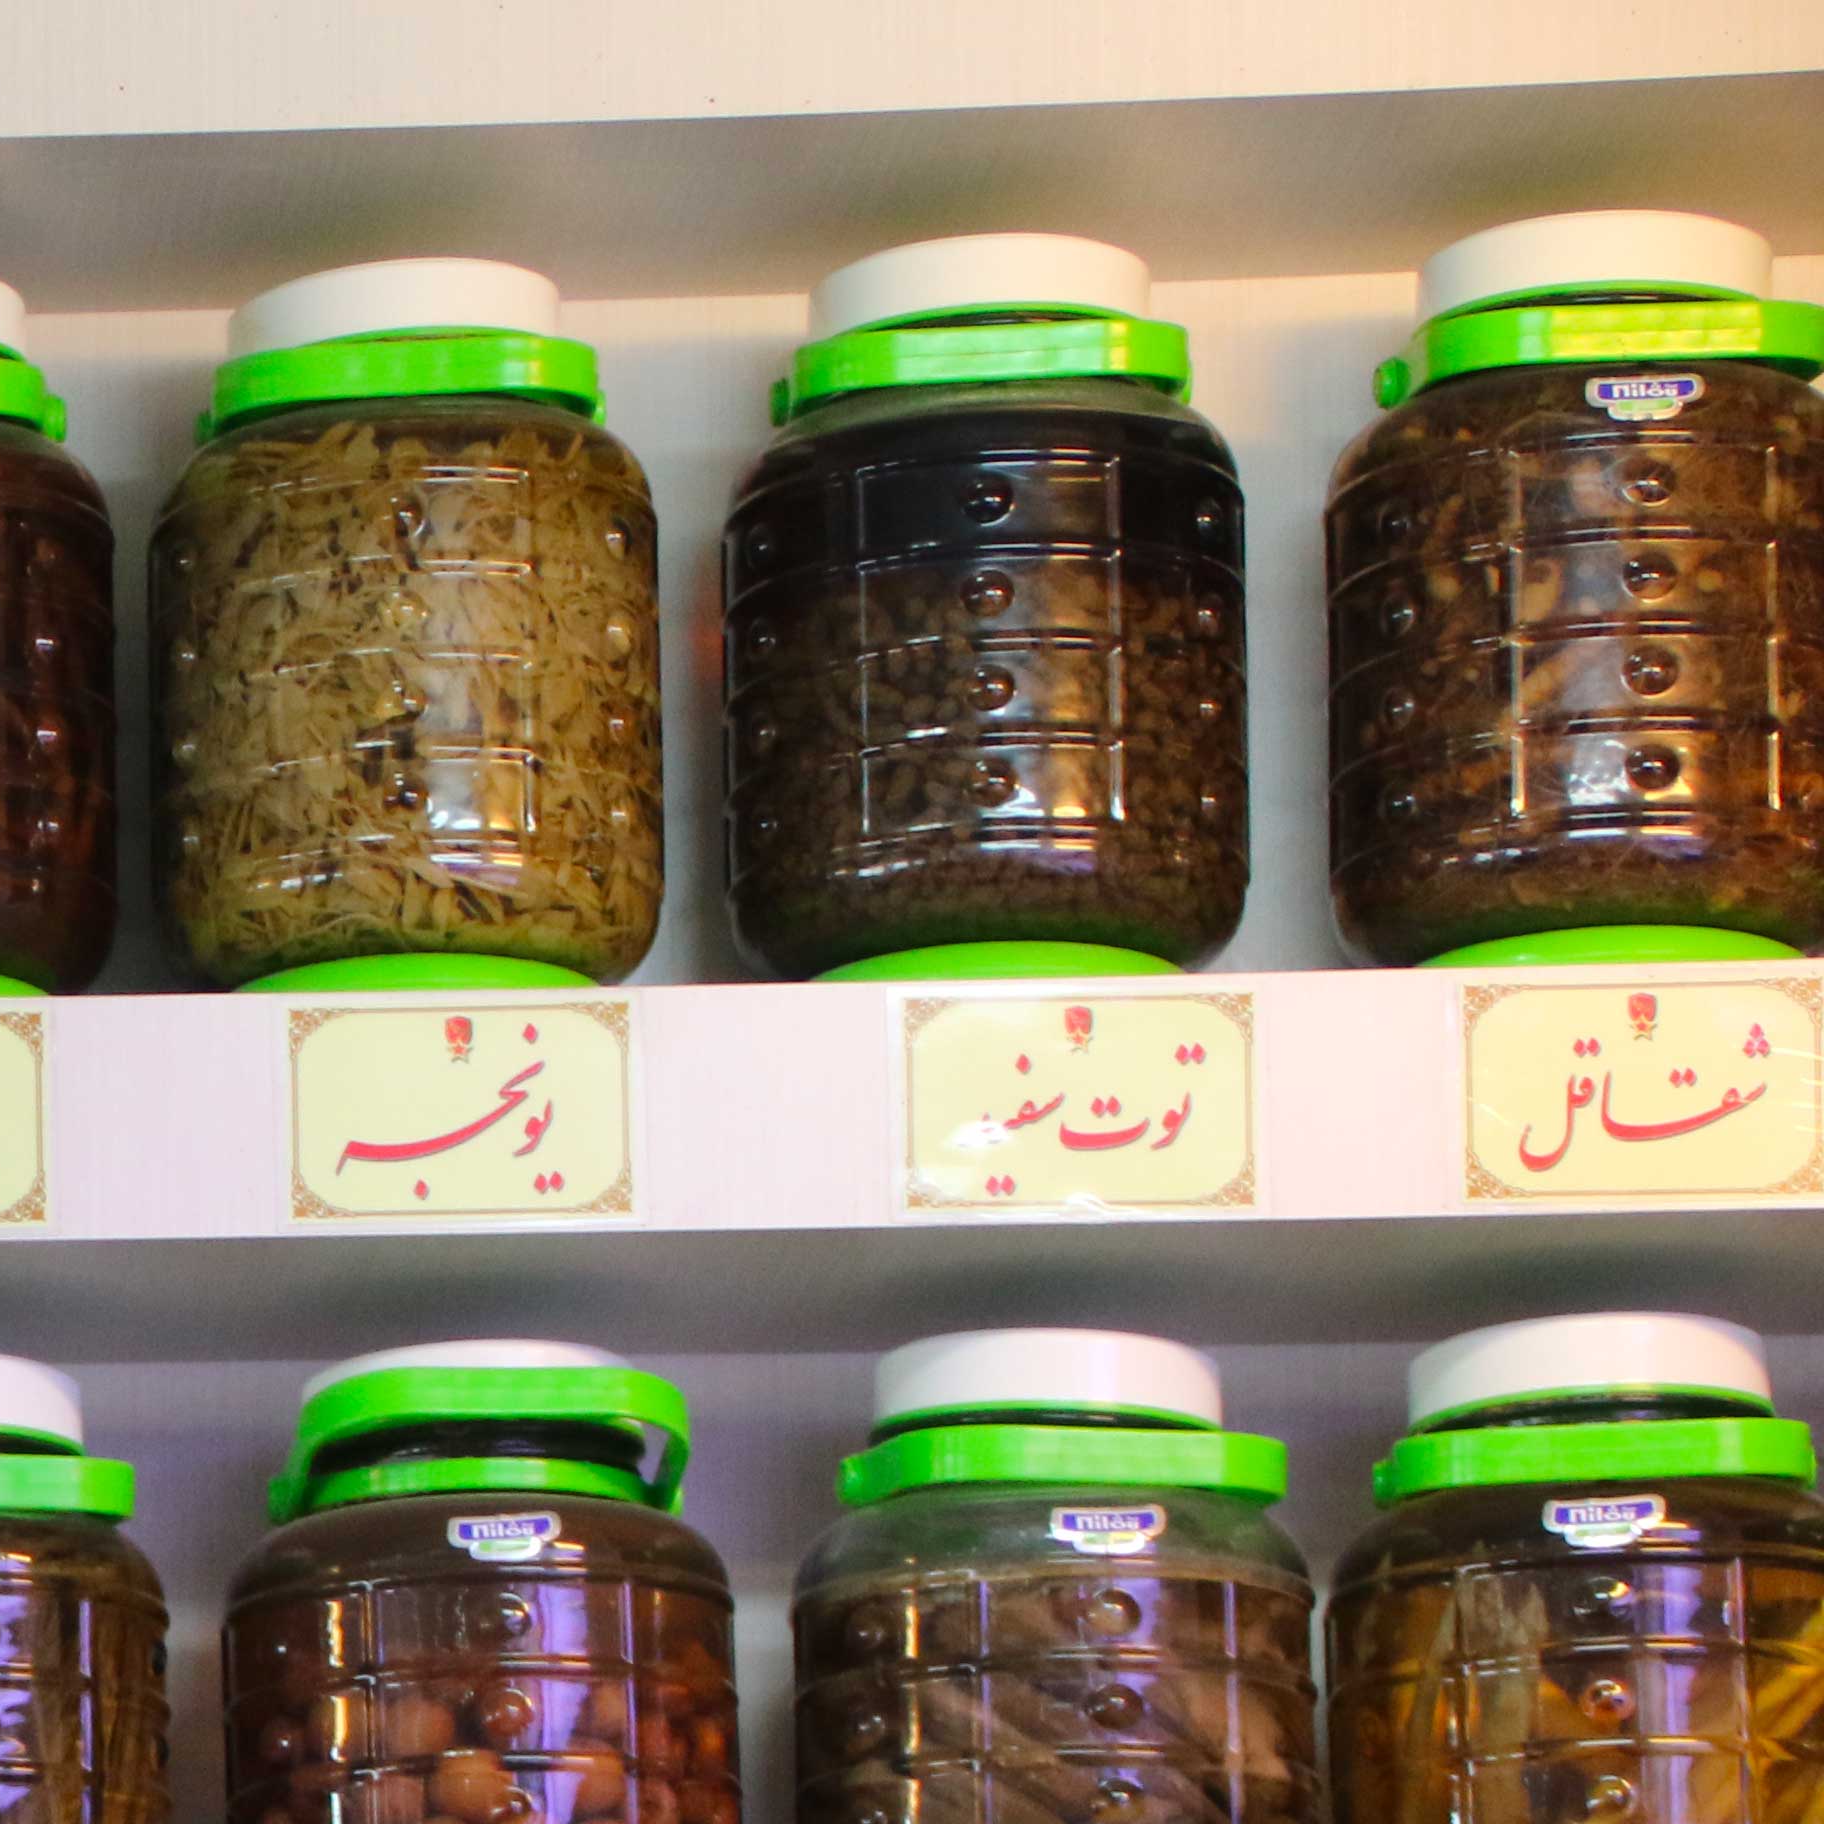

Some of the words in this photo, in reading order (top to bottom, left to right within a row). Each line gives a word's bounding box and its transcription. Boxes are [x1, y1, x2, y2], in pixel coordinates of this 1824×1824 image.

[336, 1023, 567, 1202] یونجه
[1056, 1041, 1209, 1154] توت
[1517, 1022, 1773, 1177] شقاقل
